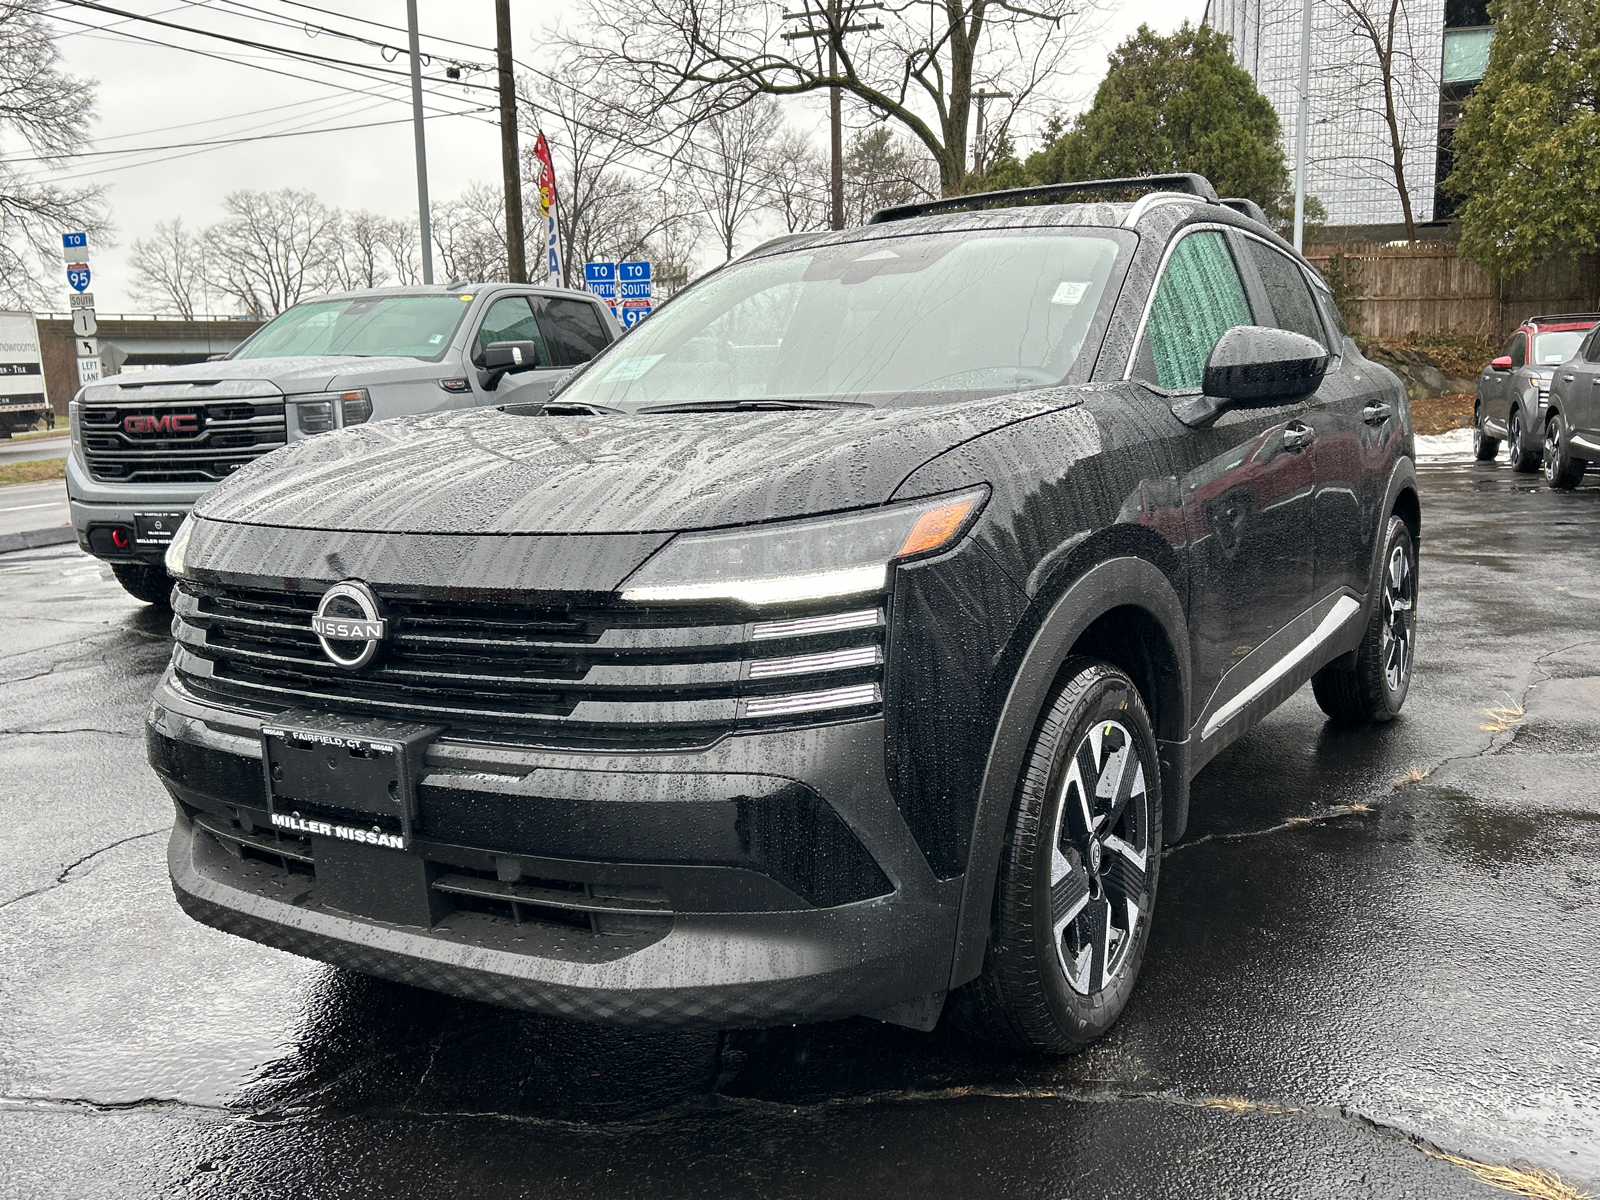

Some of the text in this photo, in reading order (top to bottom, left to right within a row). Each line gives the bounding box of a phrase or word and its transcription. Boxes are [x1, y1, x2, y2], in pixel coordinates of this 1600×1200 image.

[68, 235, 81, 245] TO
[592, 266, 608, 277] TO
[627, 266, 643, 277] TO
[70, 273, 88, 287] 95
[587, 283, 615, 295] NORTH
[621, 283, 651, 296] SOUTH
[71, 295, 94, 306] SOUTH
[82, 315, 88, 331] 1
[81, 361, 98, 371] LEFT
[82, 372, 99, 382] LANE
[124, 414, 198, 433] GMC
[312, 619, 381, 637] NISSAN
[263, 728, 285, 737] NISSAN
[292, 732, 361, 748] FAIRFIELD, CT
[370, 743, 394, 753] NISSAN
[271, 813, 404, 849] MILLER NISSAN
